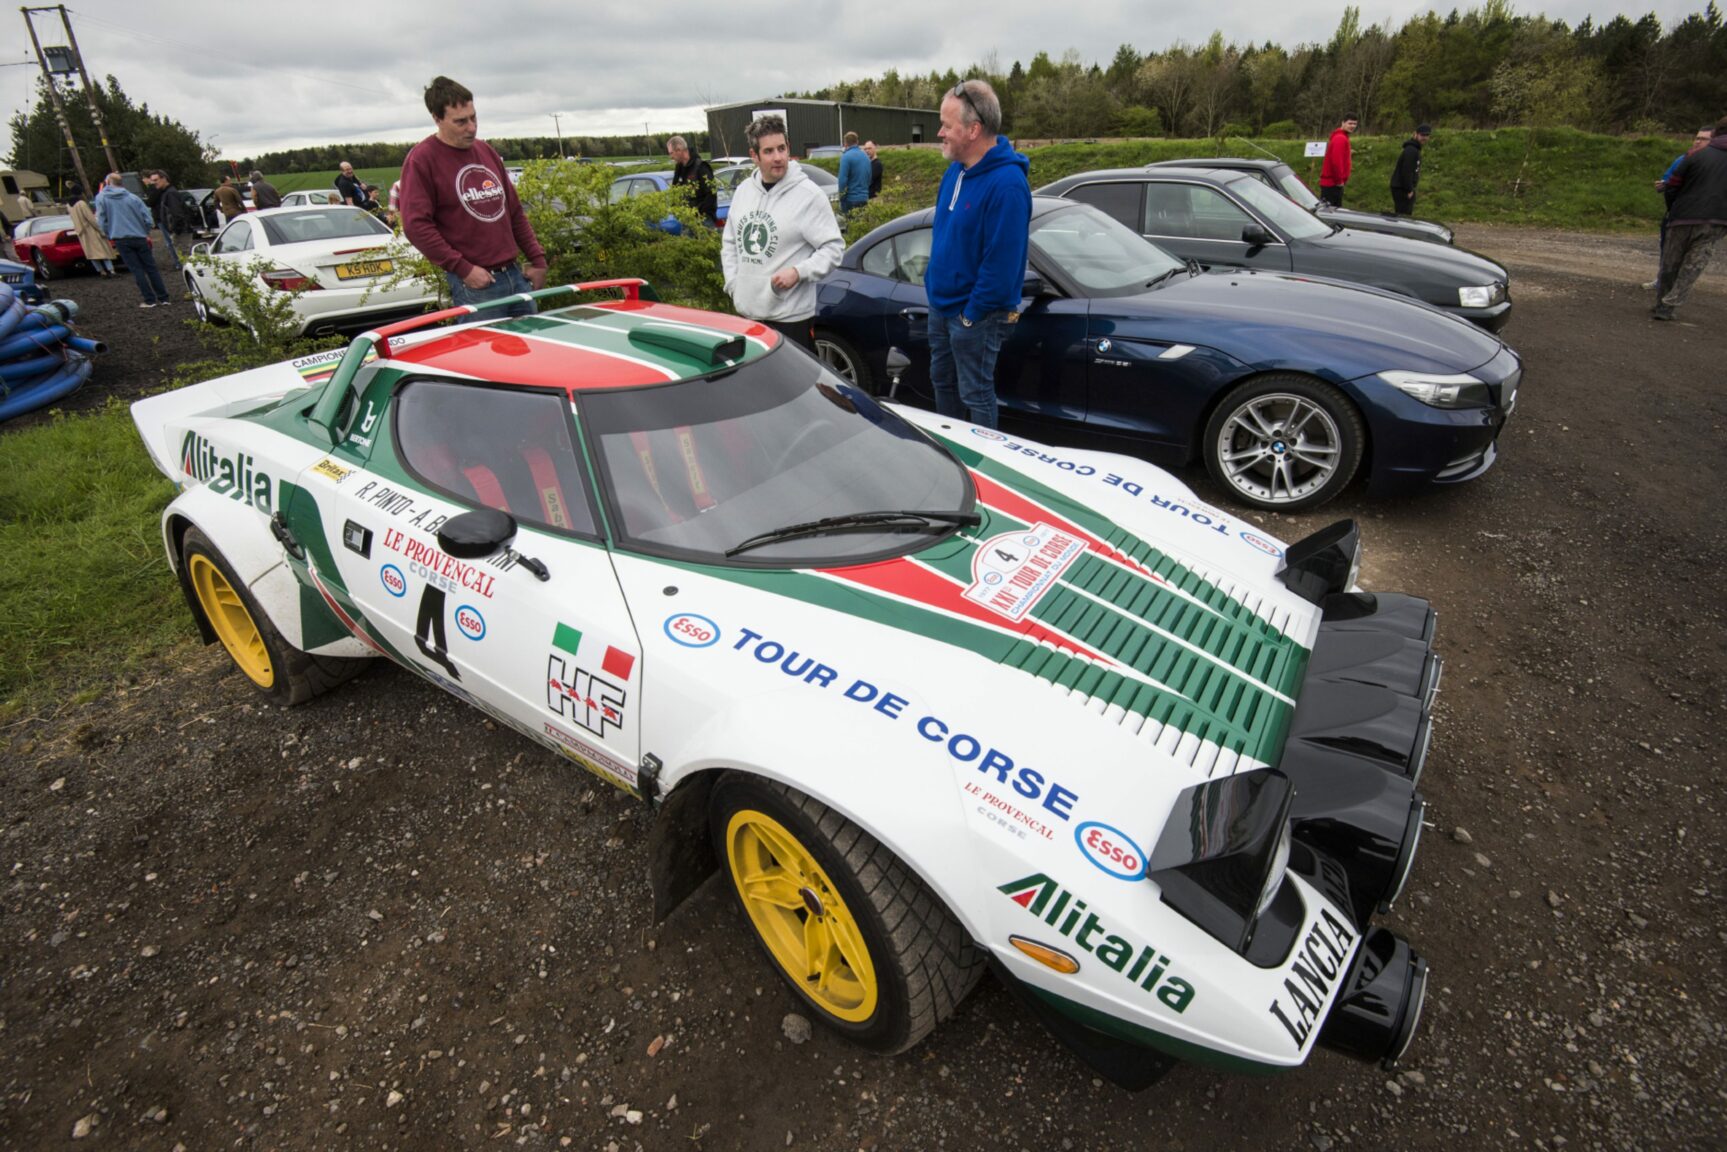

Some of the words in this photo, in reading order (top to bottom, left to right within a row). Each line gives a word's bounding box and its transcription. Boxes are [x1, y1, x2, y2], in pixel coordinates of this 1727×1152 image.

[463, 186, 504, 201] ellesse
[764, 234, 779, 258] CLUB
[180, 430, 273, 515] Alitalia
[1003, 441, 1096, 475] CORSE
[367, 487, 414, 516] PINTO
[1103, 474, 1144, 496] DE
[1150, 494, 1231, 536] TOUR
[383, 528, 403, 550] LE
[403, 537, 496, 598] PROVENCAL
[994, 548, 1019, 562] 4
[1029, 554, 1052, 570] DE
[1039, 533, 1074, 559] CORSE
[409, 561, 458, 595] CORSE
[1009, 565, 1042, 590] TOUR
[733, 627, 838, 688] TOUR
[843, 680, 910, 720] DE
[917, 716, 1080, 822] CORSE
[964, 782, 981, 797] LE
[982, 792, 1055, 841] PROVENCAL
[996, 872, 1196, 1014] Alitalia
[1269, 907, 1355, 1051] LANCIA
